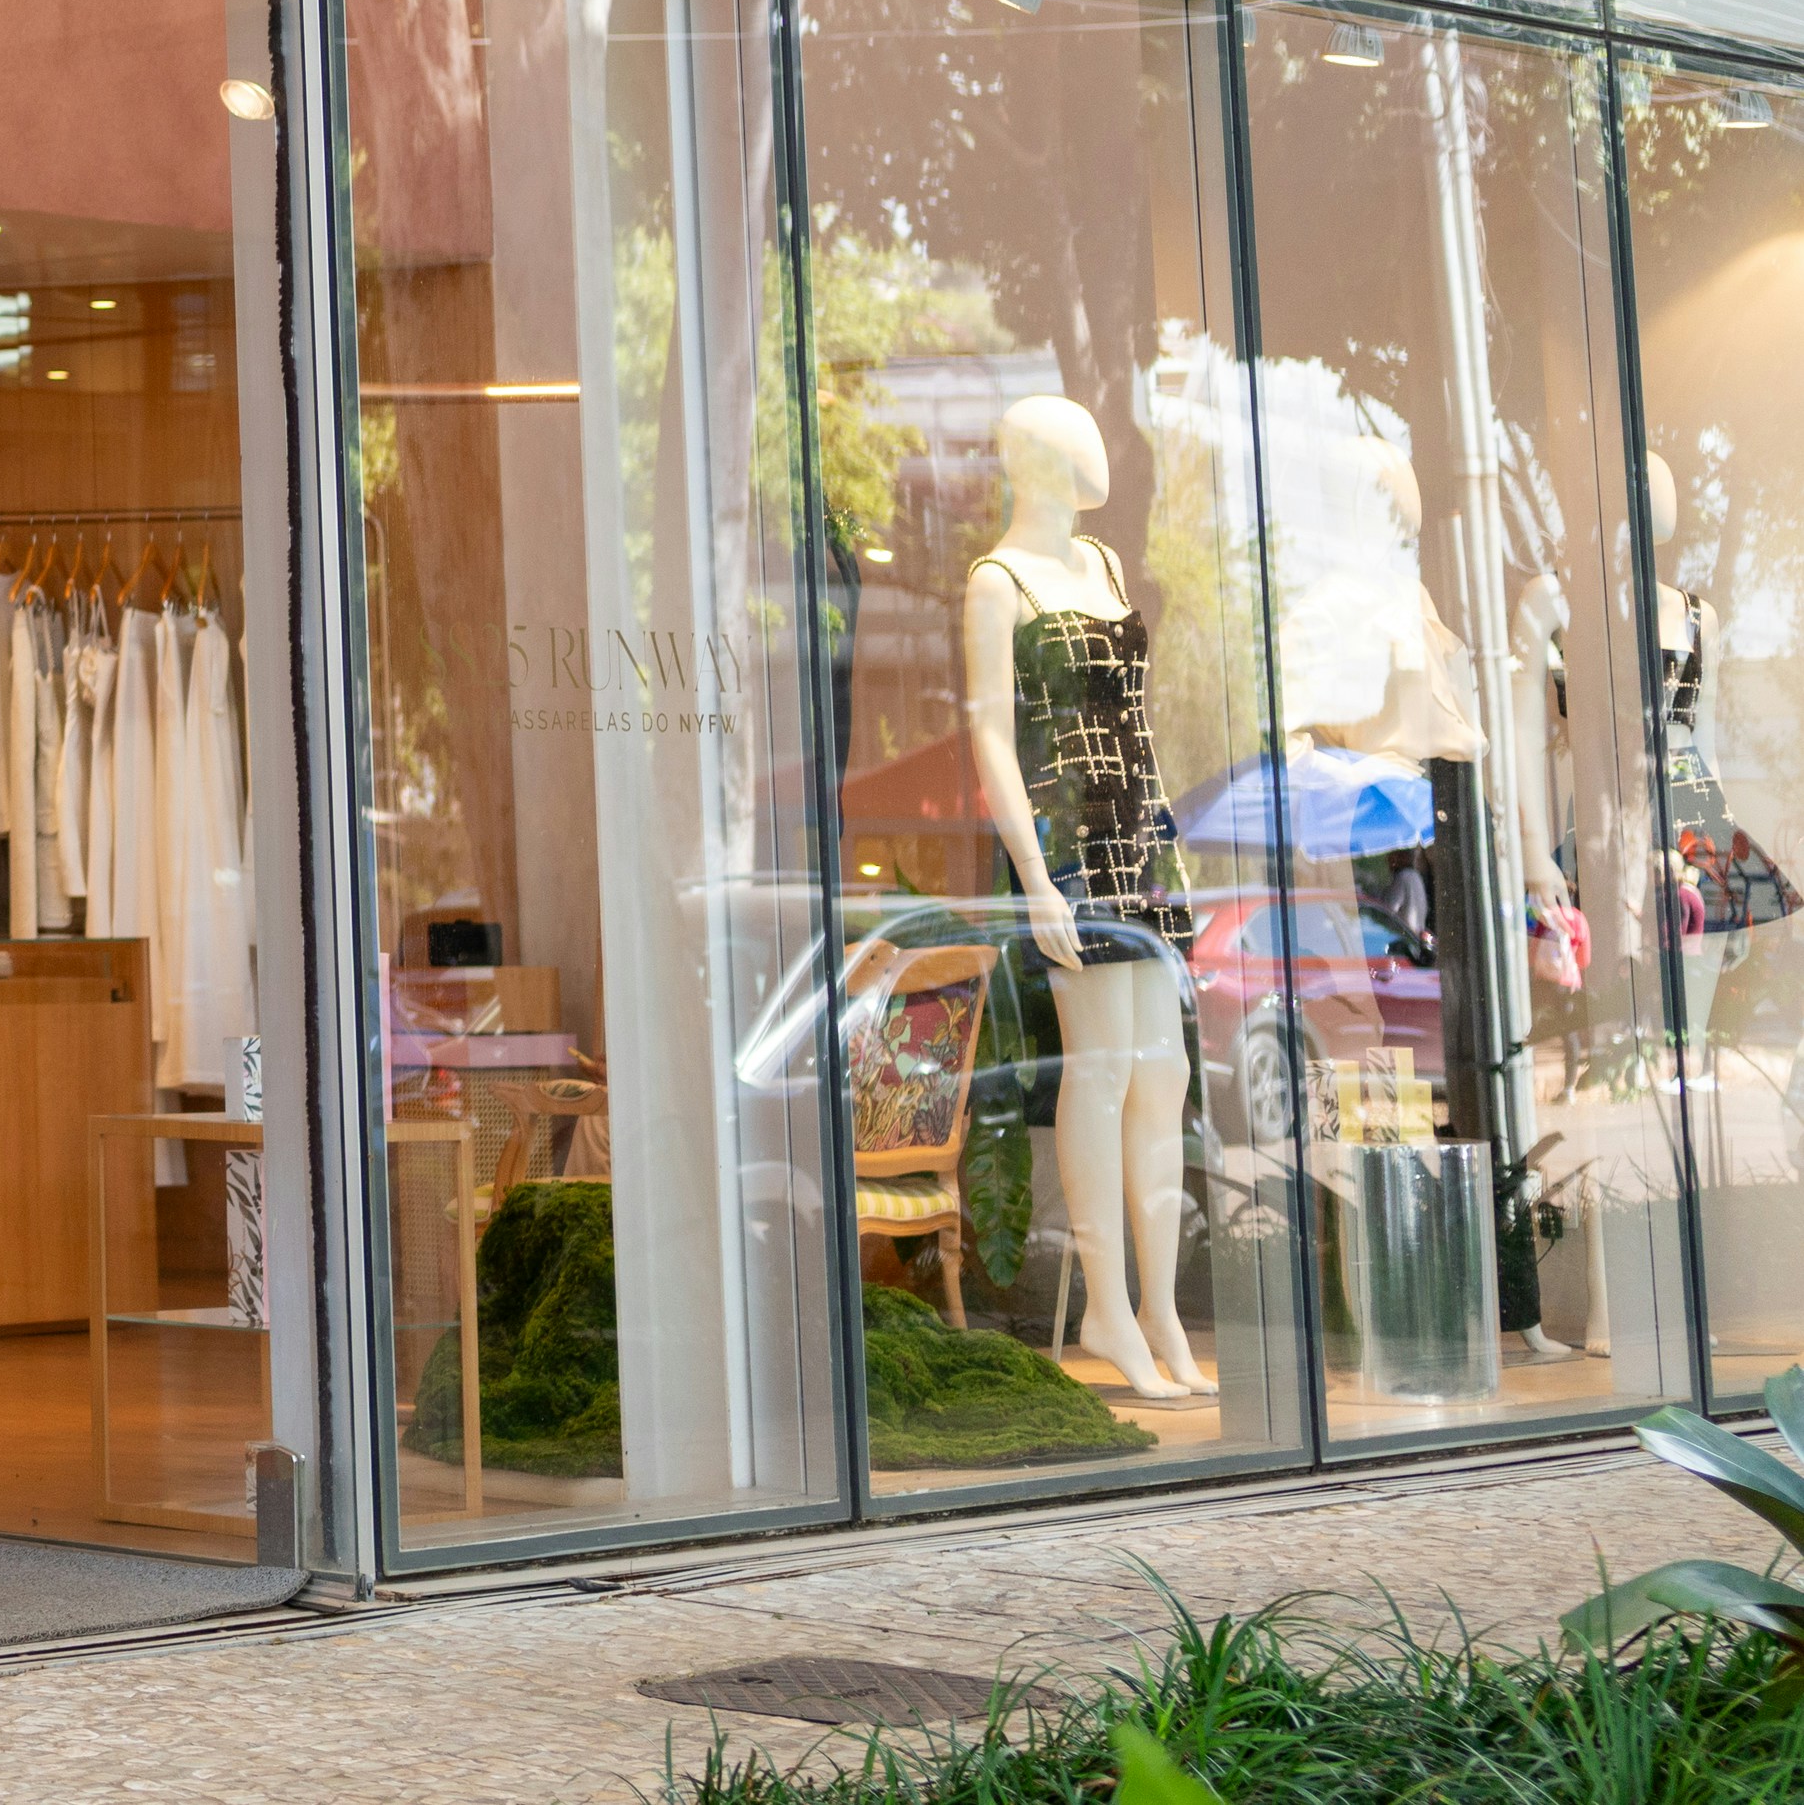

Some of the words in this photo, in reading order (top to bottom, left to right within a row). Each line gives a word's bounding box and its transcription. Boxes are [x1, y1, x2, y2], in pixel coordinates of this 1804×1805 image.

[548, 626, 752, 693] RUNWAY
[642, 712, 669, 733] DO
[679, 713, 737, 735] NYFW
